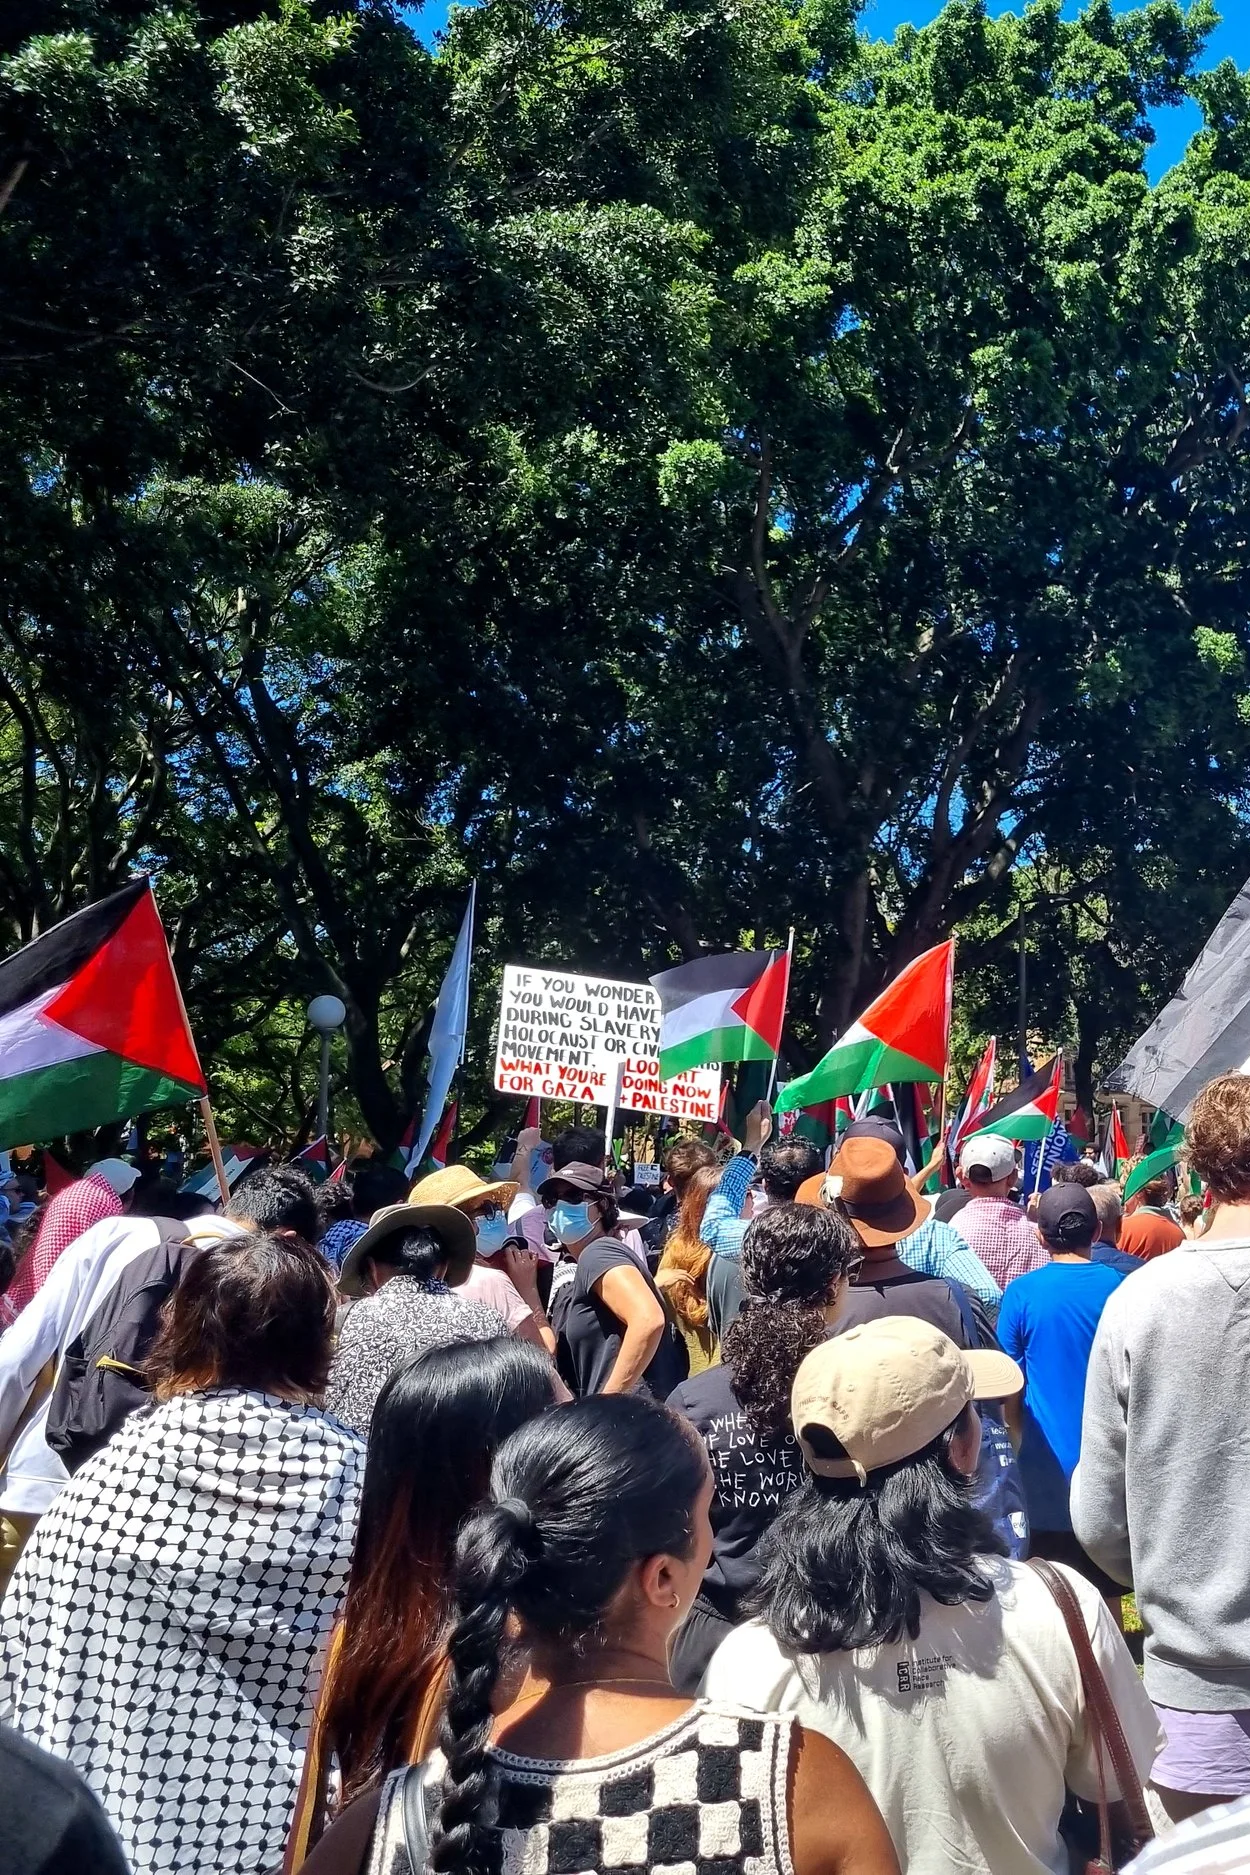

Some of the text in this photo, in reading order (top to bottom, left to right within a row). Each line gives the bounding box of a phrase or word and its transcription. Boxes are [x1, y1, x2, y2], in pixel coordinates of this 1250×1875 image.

[517, 973, 655, 1005] IF YOU WONDER
[510, 990, 661, 1024] YOU WOULD HAVE
[504, 1024, 600, 1050] HOLOCAUST
[604, 1037, 626, 1054] OR
[507, 1007, 661, 1043] DURING SLAVERY
[499, 1057, 552, 1076] WHAT
[622, 1075, 668, 1094] DOING
[672, 1083, 711, 1099] NOW
[626, 1057, 660, 1076] LOO
[499, 1073, 534, 1092] FOR
[542, 1080, 595, 1101] GAZA
[632, 1091, 716, 1119] PALESTINE
[1043, 1124, 1068, 1171] UNION
[729, 1432, 769, 1448] LOVE
[740, 1449, 794, 1468] LOVE
[760, 1471, 805, 1491] WORL
[718, 1490, 779, 1509] KNOW
[897, 1661, 911, 1692] ICRR
[913, 1680, 945, 1690] Research
